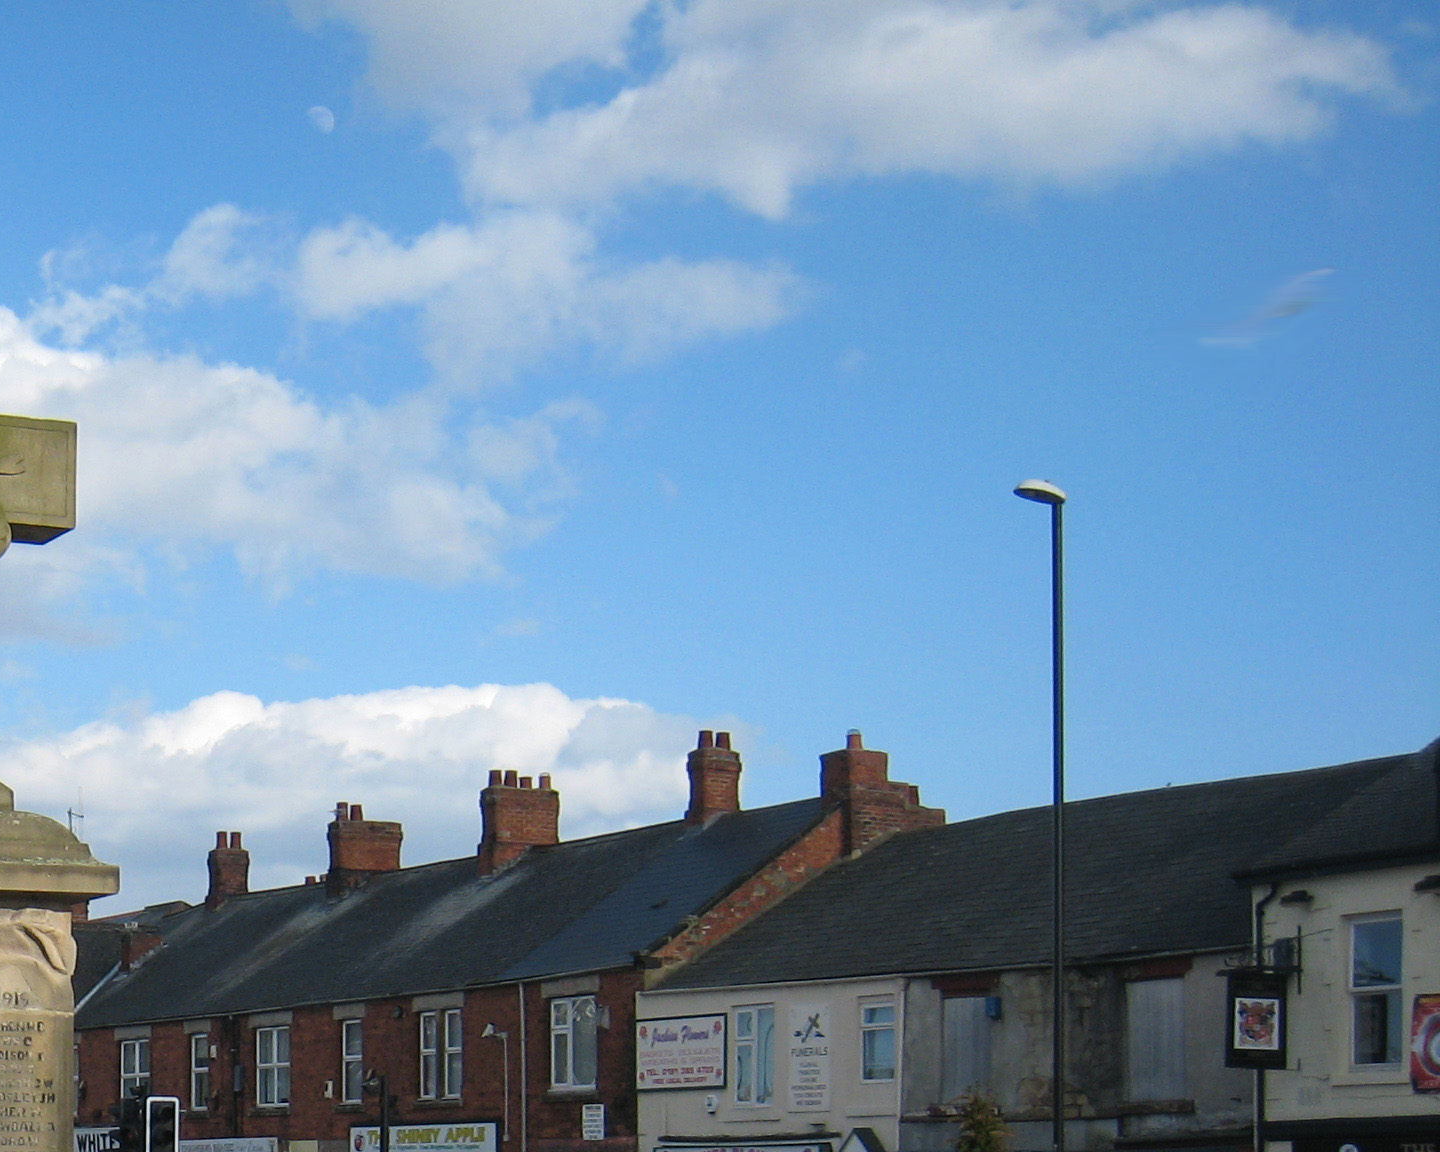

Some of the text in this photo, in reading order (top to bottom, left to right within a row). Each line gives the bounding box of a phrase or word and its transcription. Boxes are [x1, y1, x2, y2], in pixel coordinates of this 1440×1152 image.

[790, 1046, 829, 1057] FUNERALS
[367, 1127, 486, 1146] TH SHINEY APPLE
